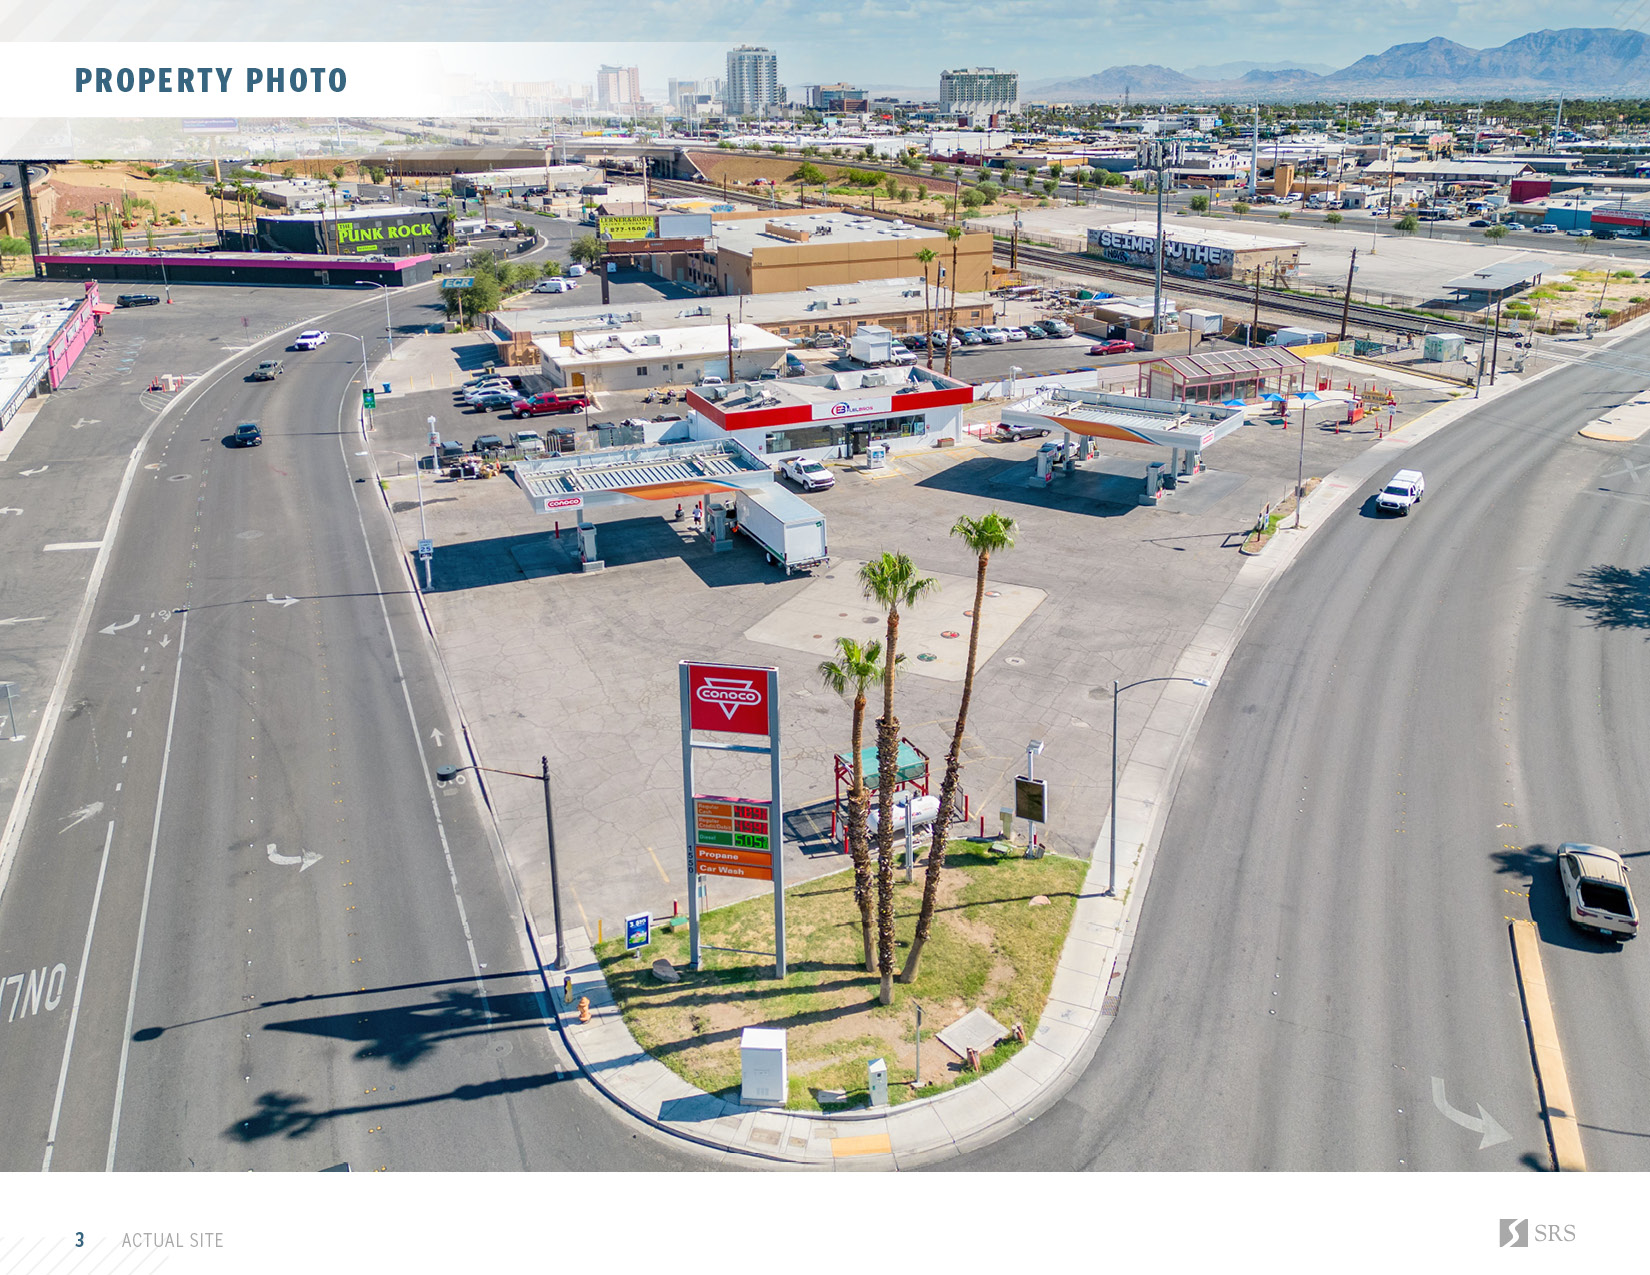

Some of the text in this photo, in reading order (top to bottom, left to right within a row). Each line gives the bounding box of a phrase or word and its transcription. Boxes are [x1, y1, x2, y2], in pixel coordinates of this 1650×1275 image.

[338, 223, 432, 243] PUNK ROCK
[445, 279, 470, 287] ECR
[699, 833, 717, 841] Diesel
[699, 850, 739, 860] Propane
[699, 864, 744, 875] Car Wash
